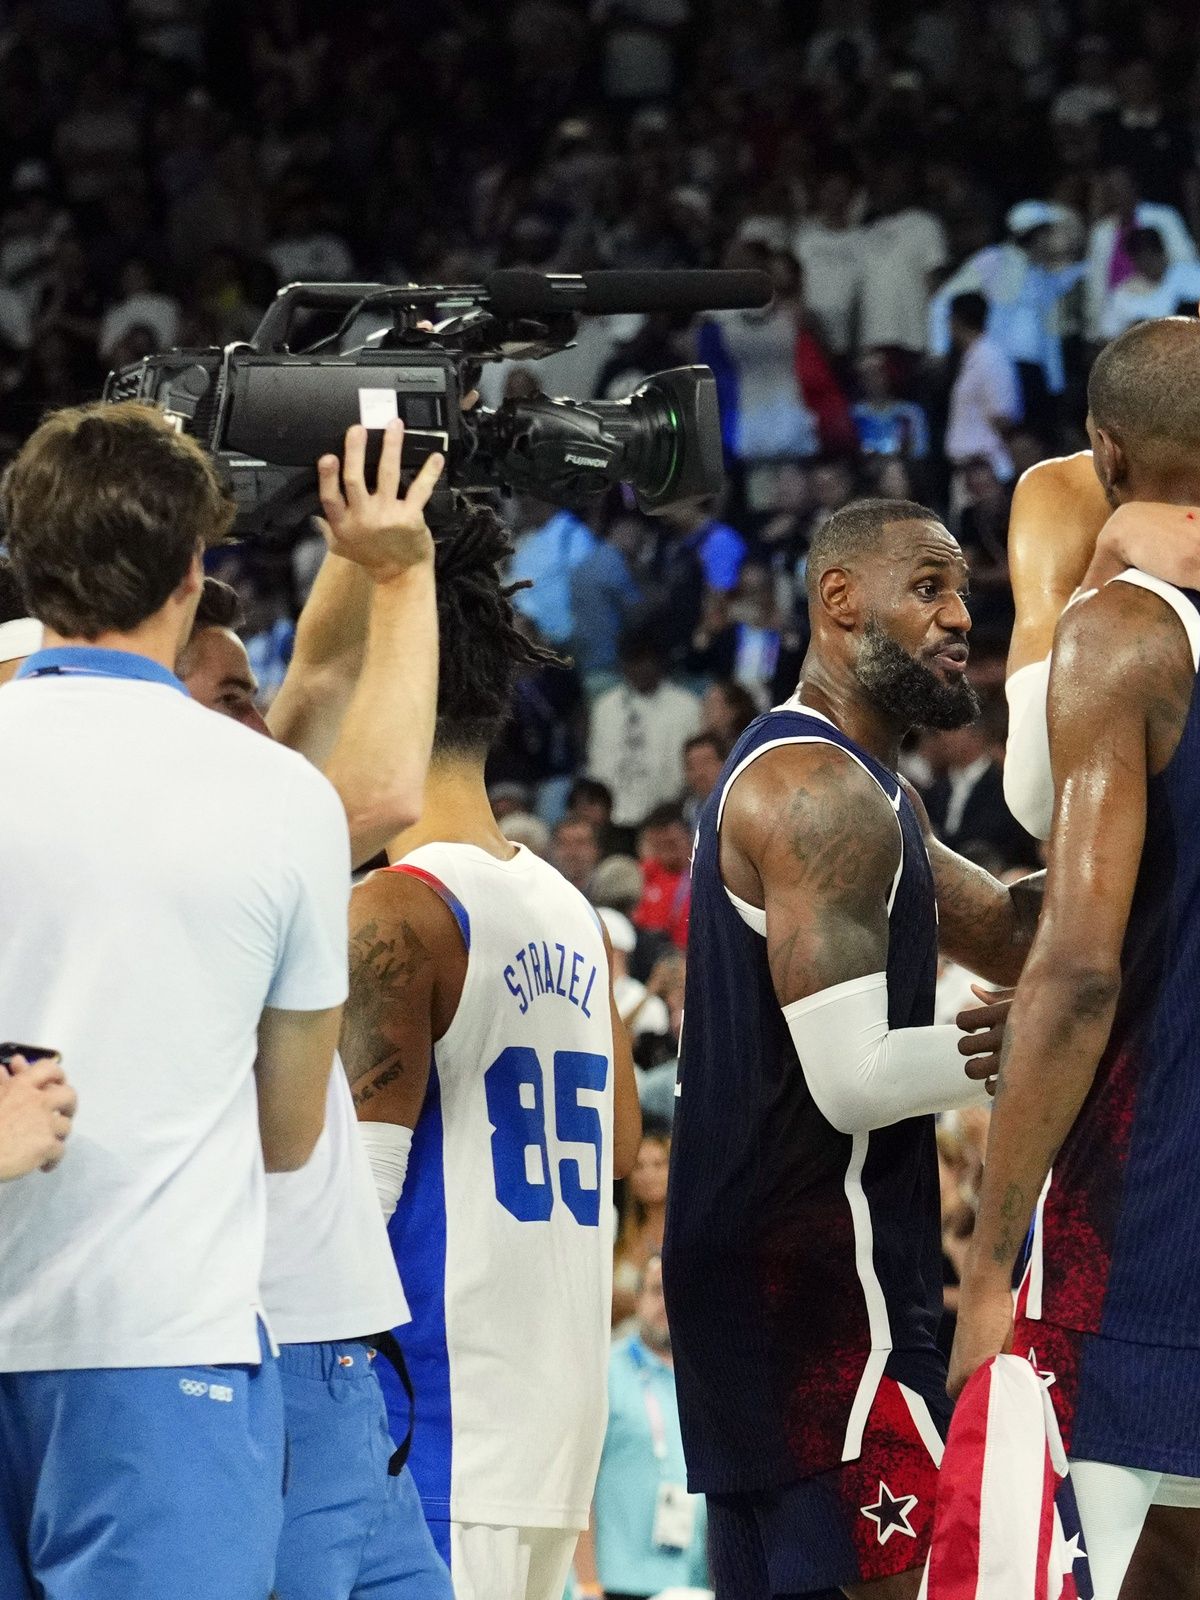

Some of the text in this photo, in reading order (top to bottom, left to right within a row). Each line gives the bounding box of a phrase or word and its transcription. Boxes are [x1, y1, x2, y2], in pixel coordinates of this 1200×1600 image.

[564, 454, 608, 468] FUJINON
[503, 941, 597, 1018] STRAZEL
[484, 1046, 608, 1226] 85
